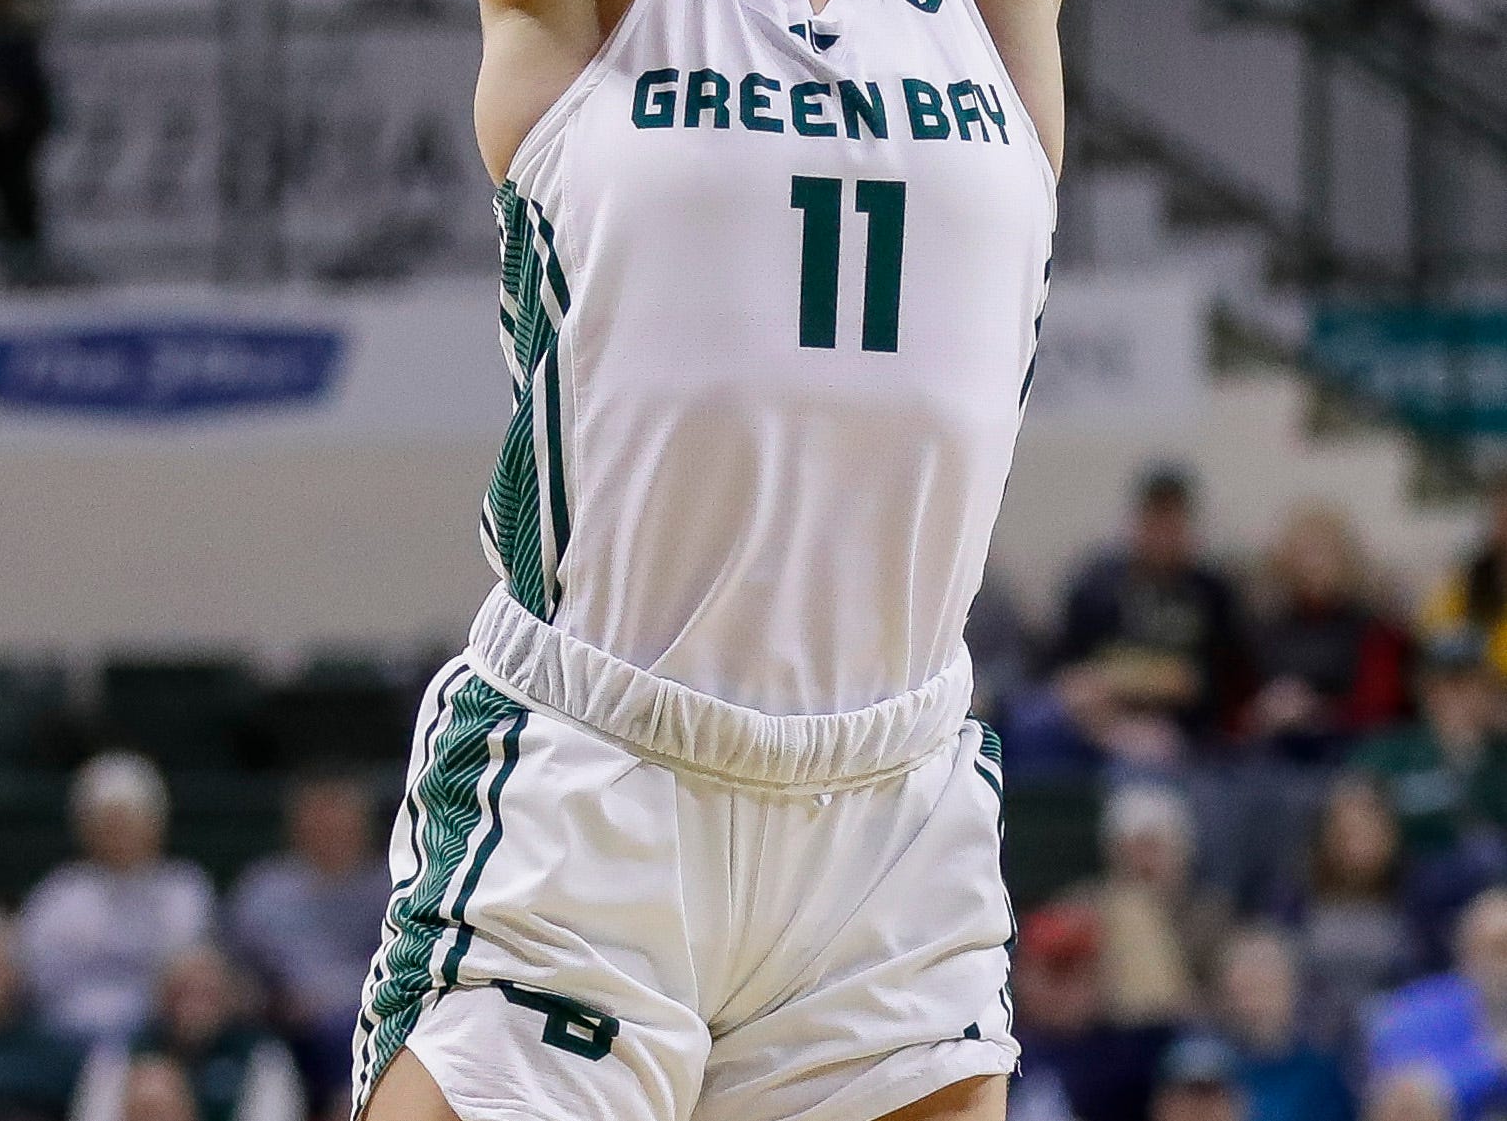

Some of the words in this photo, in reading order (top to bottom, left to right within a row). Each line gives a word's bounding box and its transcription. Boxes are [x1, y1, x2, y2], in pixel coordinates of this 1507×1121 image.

[630, 67, 890, 142] GREEN
[901, 78, 1011, 146] BAY
[790, 175, 907, 354] 11
